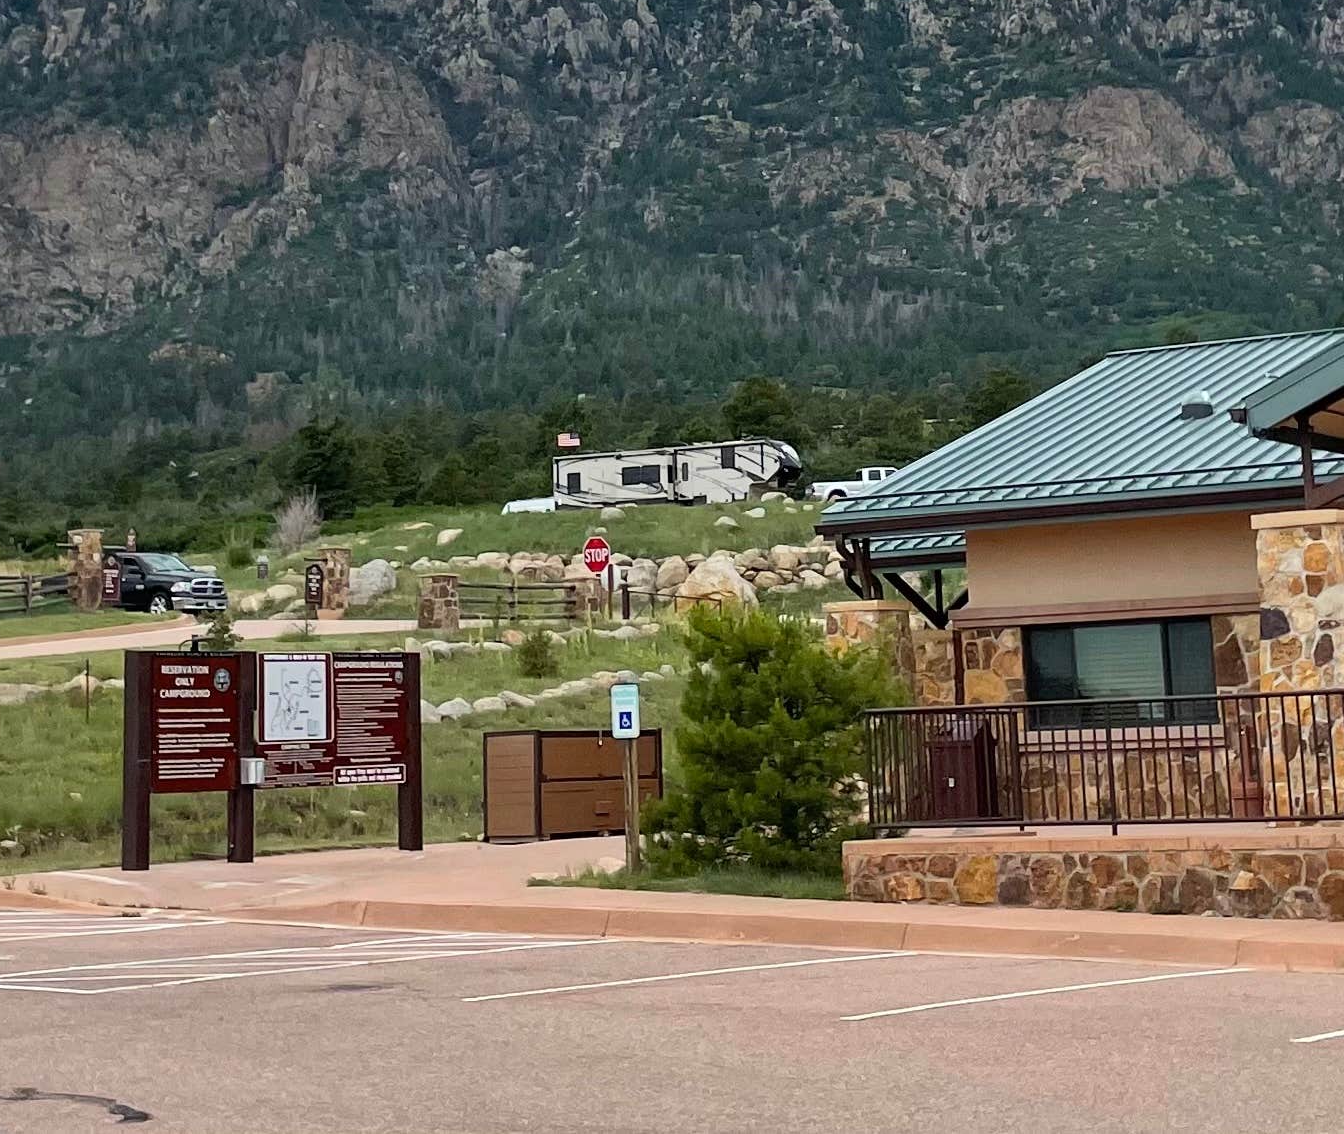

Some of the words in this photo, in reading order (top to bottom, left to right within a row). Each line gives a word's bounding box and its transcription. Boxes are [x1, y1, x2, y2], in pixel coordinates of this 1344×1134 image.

[585, 548, 608, 563] STOP
[161, 665, 209, 674] RESERVATION
[175, 677, 195, 686] ONLY
[160, 689, 211, 698] CAMPGROUND
